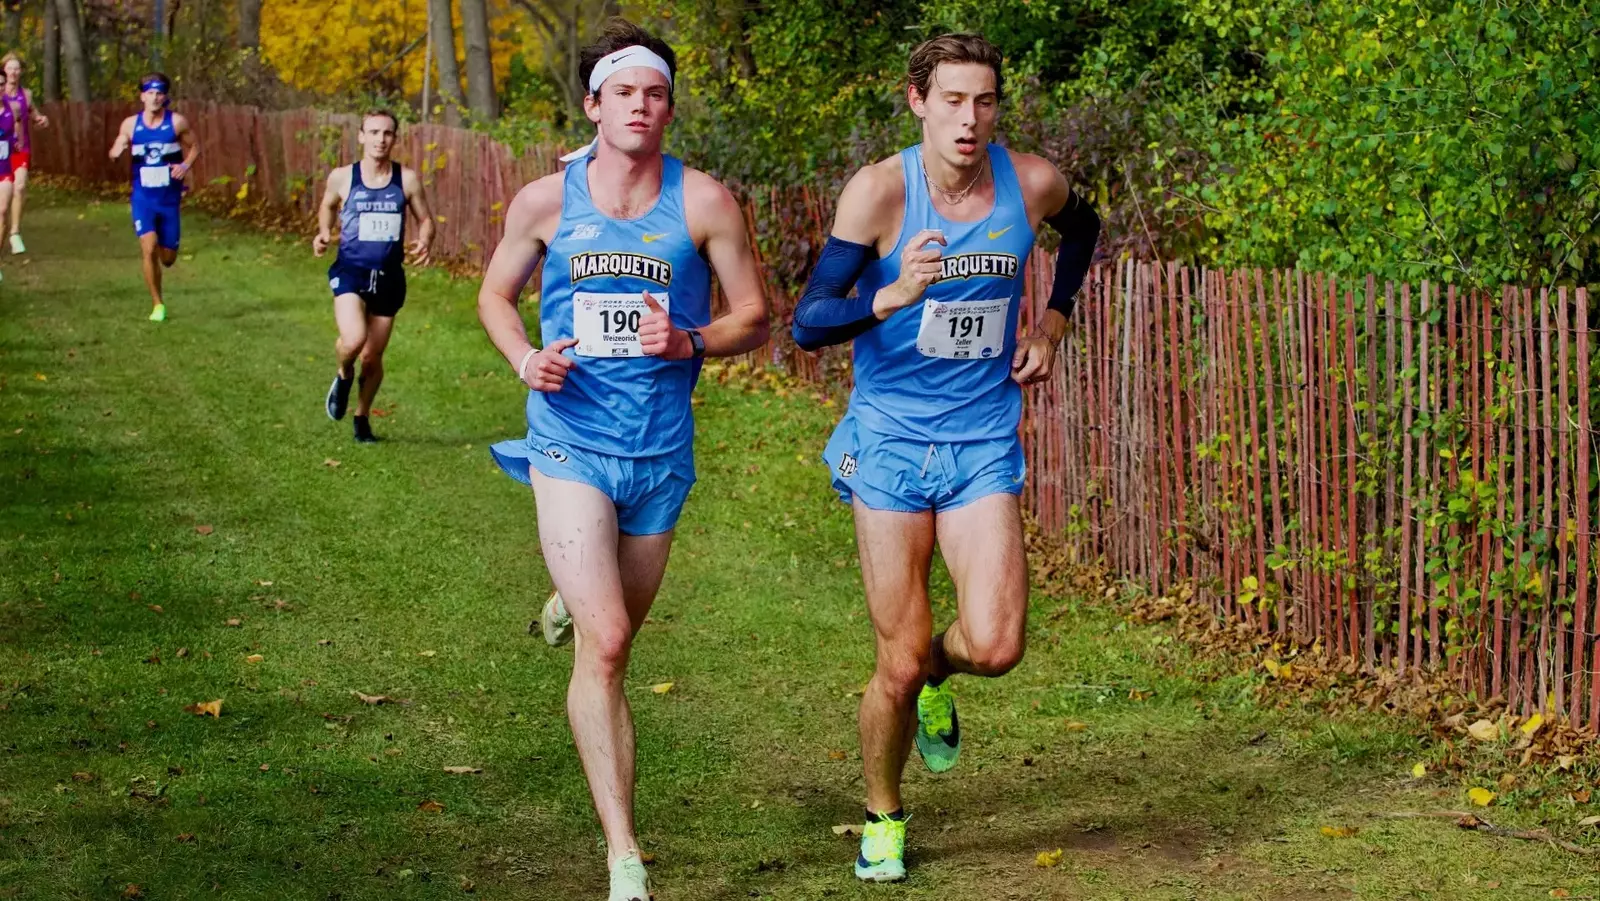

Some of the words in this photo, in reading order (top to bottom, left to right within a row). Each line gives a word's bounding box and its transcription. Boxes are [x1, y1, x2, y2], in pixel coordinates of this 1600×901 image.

[356, 201, 398, 211] BUTLER
[372, 220, 390, 231] 113
[572, 254, 671, 283] MARQUETTE
[941, 255, 1017, 278] ARQUETTE
[600, 310, 641, 333] 190
[949, 315, 984, 338] 191
